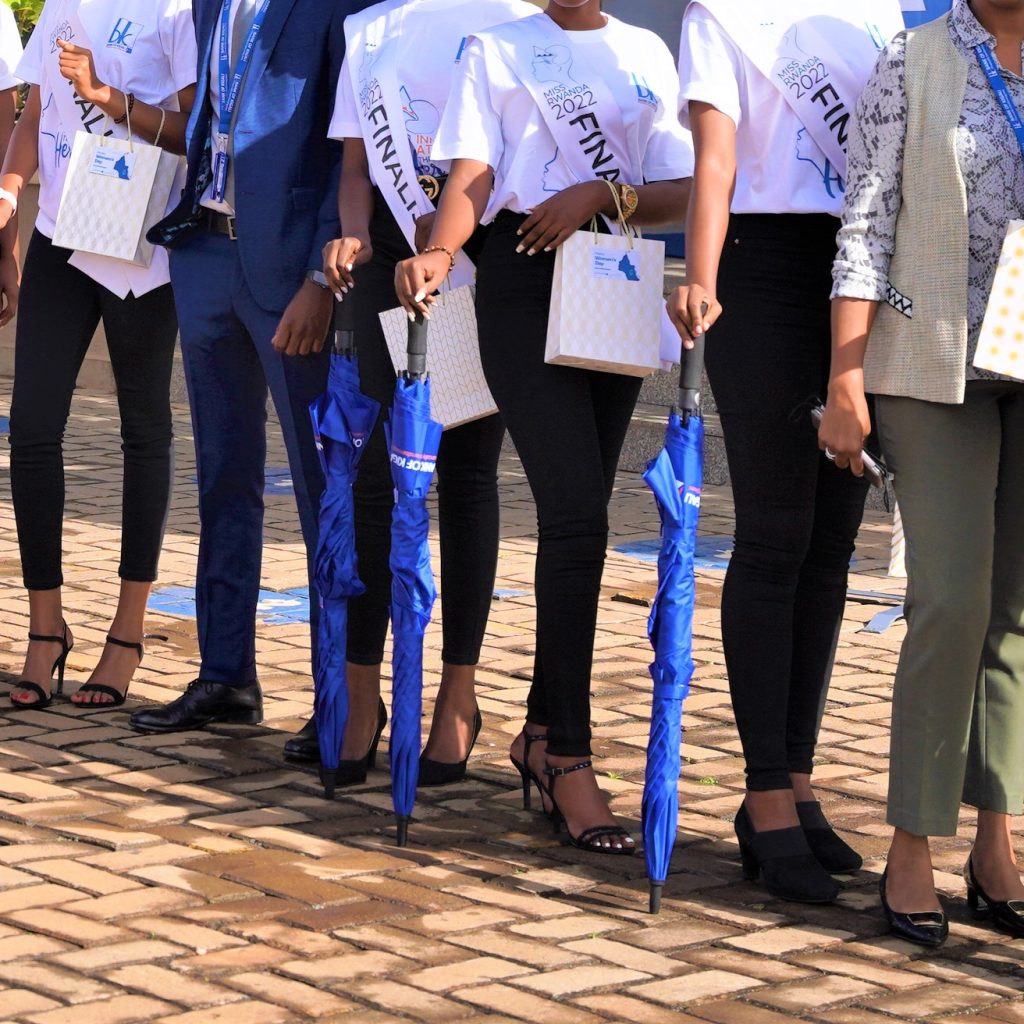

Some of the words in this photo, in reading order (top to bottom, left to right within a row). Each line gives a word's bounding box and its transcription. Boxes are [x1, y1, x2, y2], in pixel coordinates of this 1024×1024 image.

[50, 25, 75, 53] 222
[777, 60, 800, 80] MISS
[783, 55, 821, 87] RWANDA
[789, 62, 829, 100] 2022
[543, 84, 566, 99] MISS
[547, 83, 590, 106] RWANDA
[551, 90, 597, 120] 2022
[368, 104, 417, 224] FINALI
